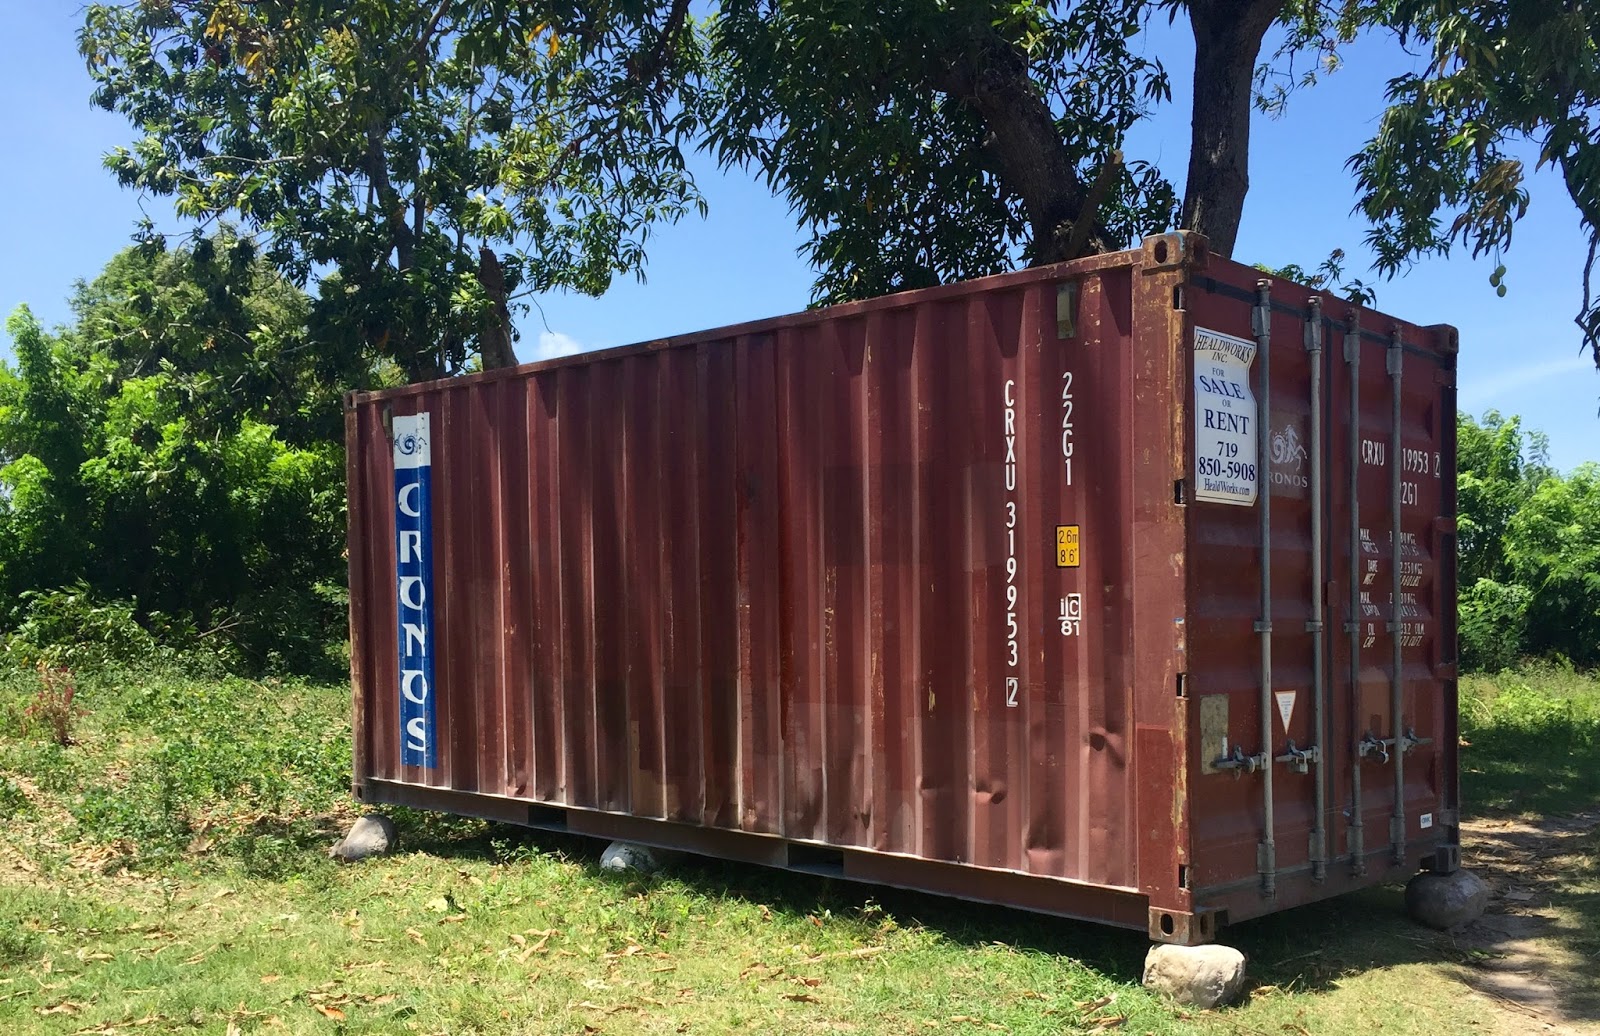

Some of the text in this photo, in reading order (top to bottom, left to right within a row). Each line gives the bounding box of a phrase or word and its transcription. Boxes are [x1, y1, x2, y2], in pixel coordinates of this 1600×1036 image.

[1194, 334, 1253, 364] HEALDWORKS
[1211, 351, 1228, 364] INC.
[1212, 367, 1225, 378] FOR
[1199, 375, 1246, 400] SALE
[1222, 399, 1232, 408] OR
[1062, 371, 1073, 486] 22G1
[1204, 408, 1250, 435] RENT
[1216, 441, 1238, 458] 719
[1362, 439, 1385, 466] CRXU
[1402, 447, 1429, 474] 19953
[1199, 457, 1256, 482] 850-5908
[1269, 471, 1308, 488] RONOS
[1204, 477, 1250, 496] HealdWorks.com
[1400, 481, 1418, 506] 2G1
[1004, 379, 1018, 706] CRXU 319953 2
[398, 482, 428, 751] CRONOS
[1061, 620, 1080, 636] 81
